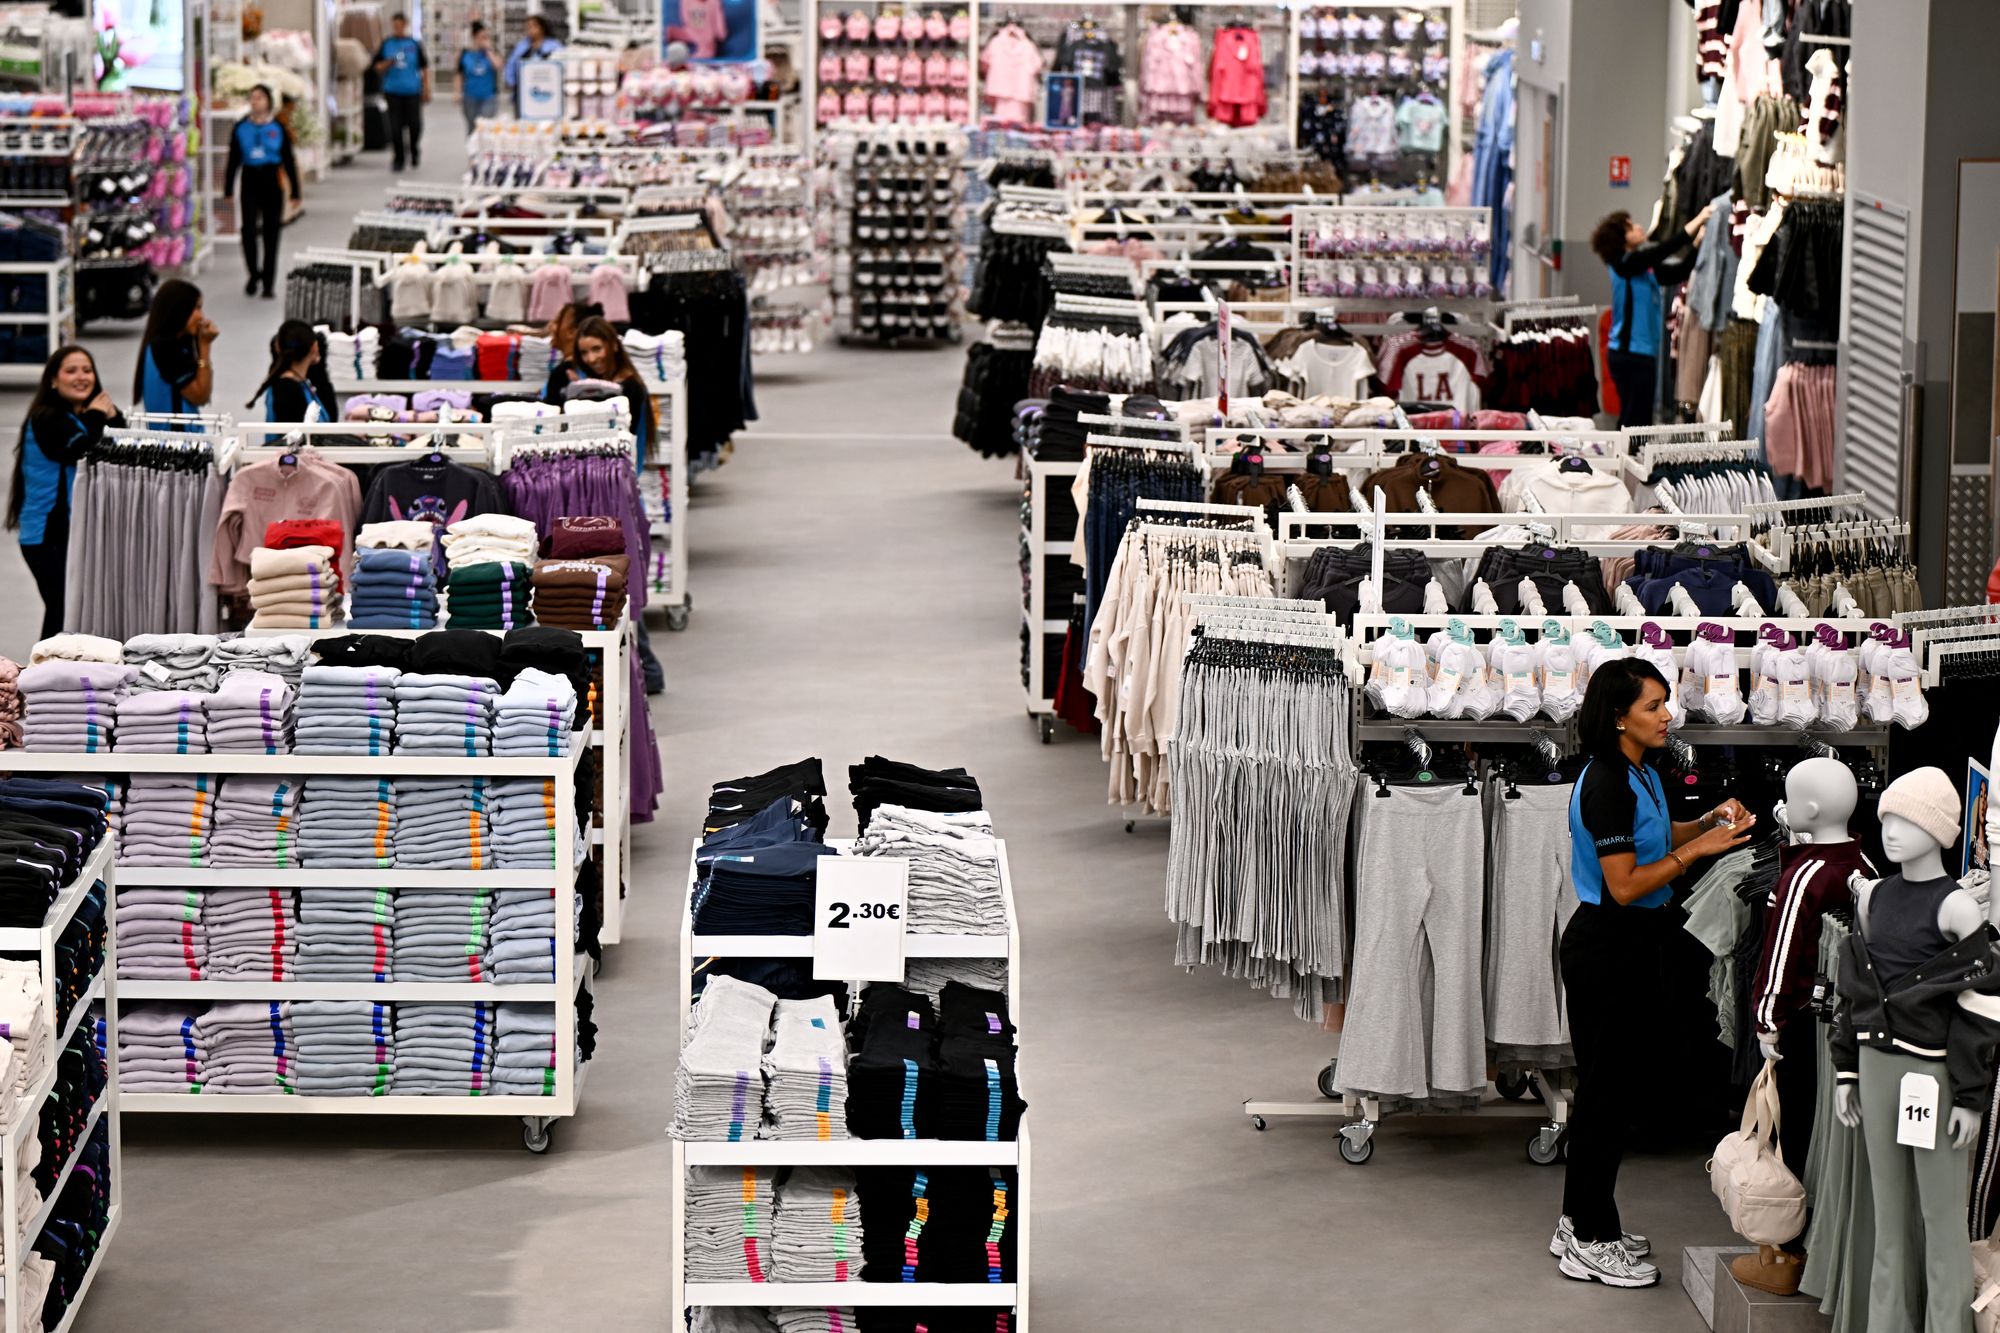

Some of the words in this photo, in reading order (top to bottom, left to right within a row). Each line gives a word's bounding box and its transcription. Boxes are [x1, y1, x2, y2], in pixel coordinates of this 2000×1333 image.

[1416, 372, 1453, 400] LA
[828, 902, 900, 928] 2.30€
[1905, 1105, 1931, 1121] 11€
[1598, 1255, 1615, 1268] N
